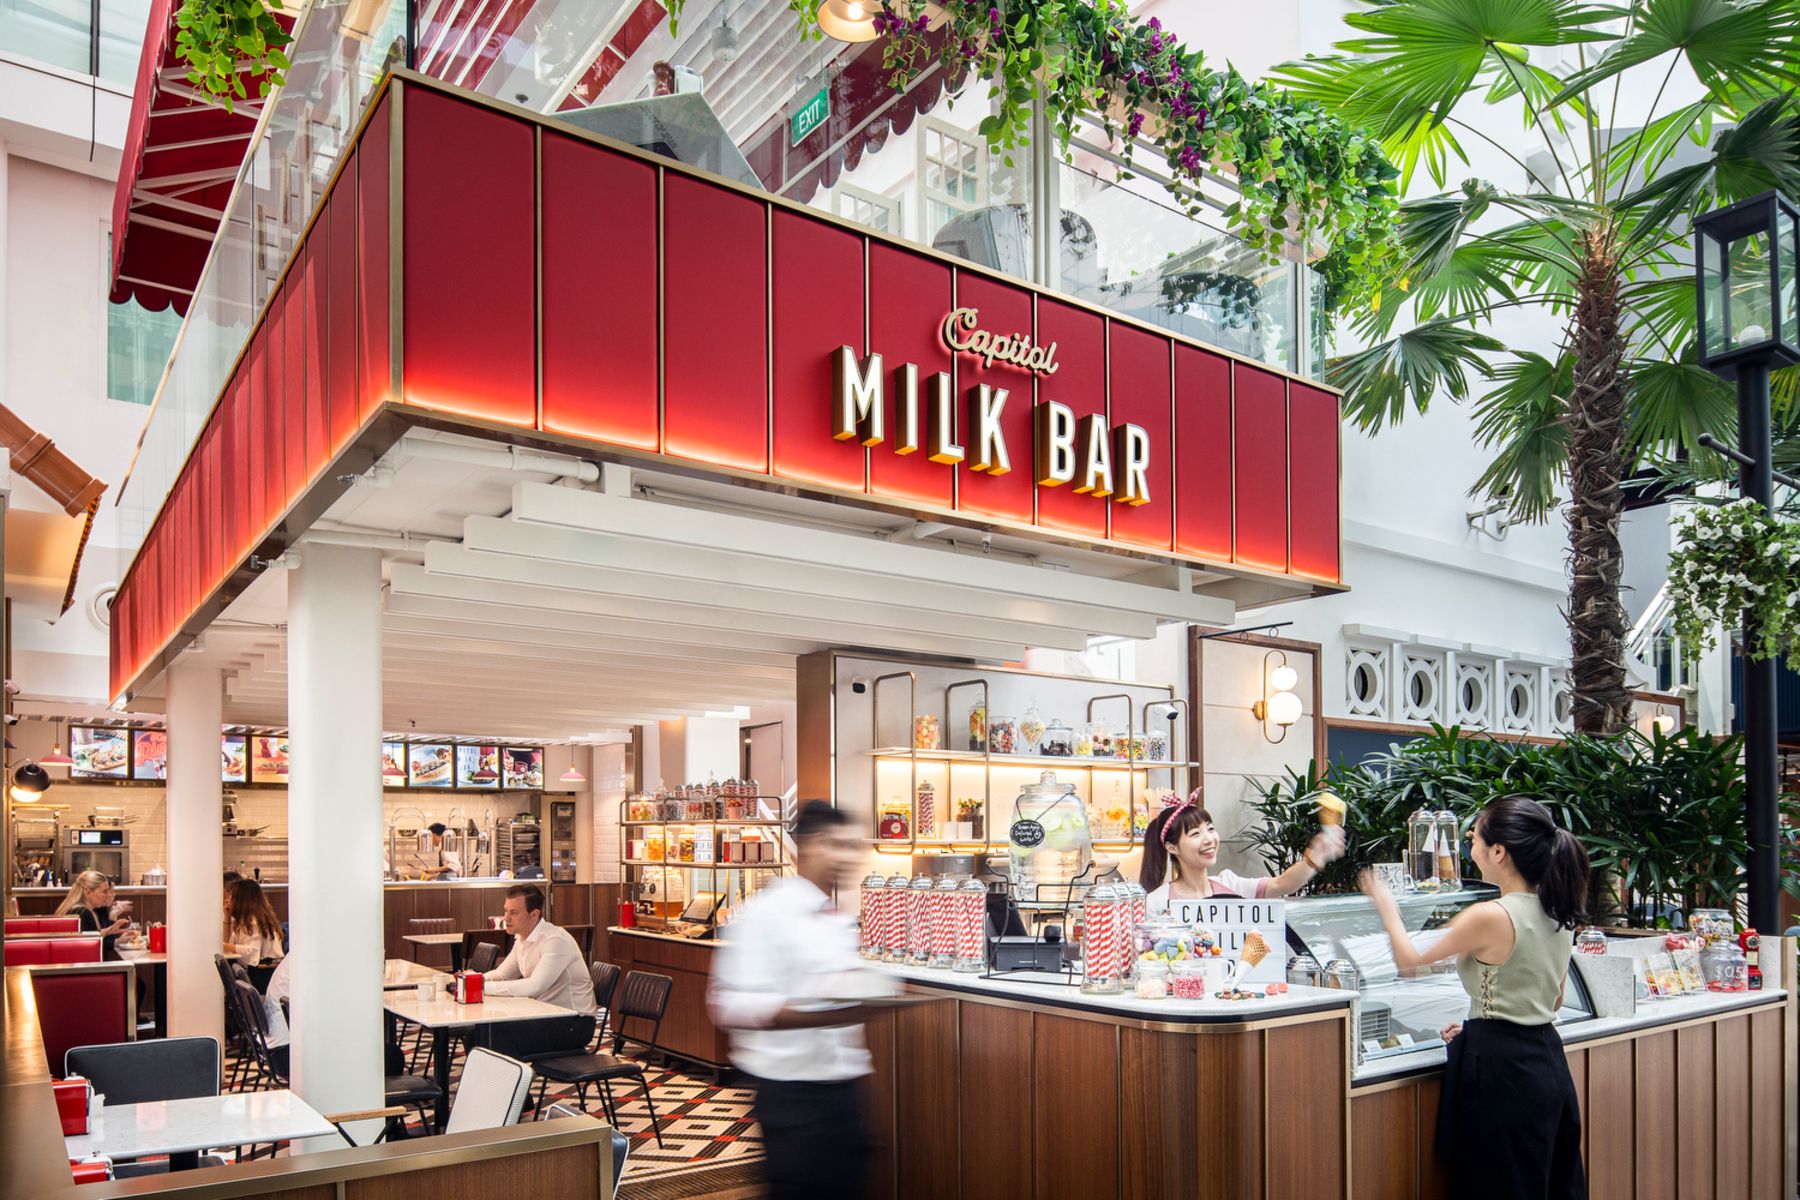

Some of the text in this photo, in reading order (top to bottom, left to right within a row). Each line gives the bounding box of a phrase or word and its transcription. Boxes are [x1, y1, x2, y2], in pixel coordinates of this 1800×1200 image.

[799, 98, 820, 134] EXIT
[944, 307, 1060, 375] Capitol
[835, 345, 1152, 506] MILK BAR
[1182, 905, 1275, 924] CAPITOL
